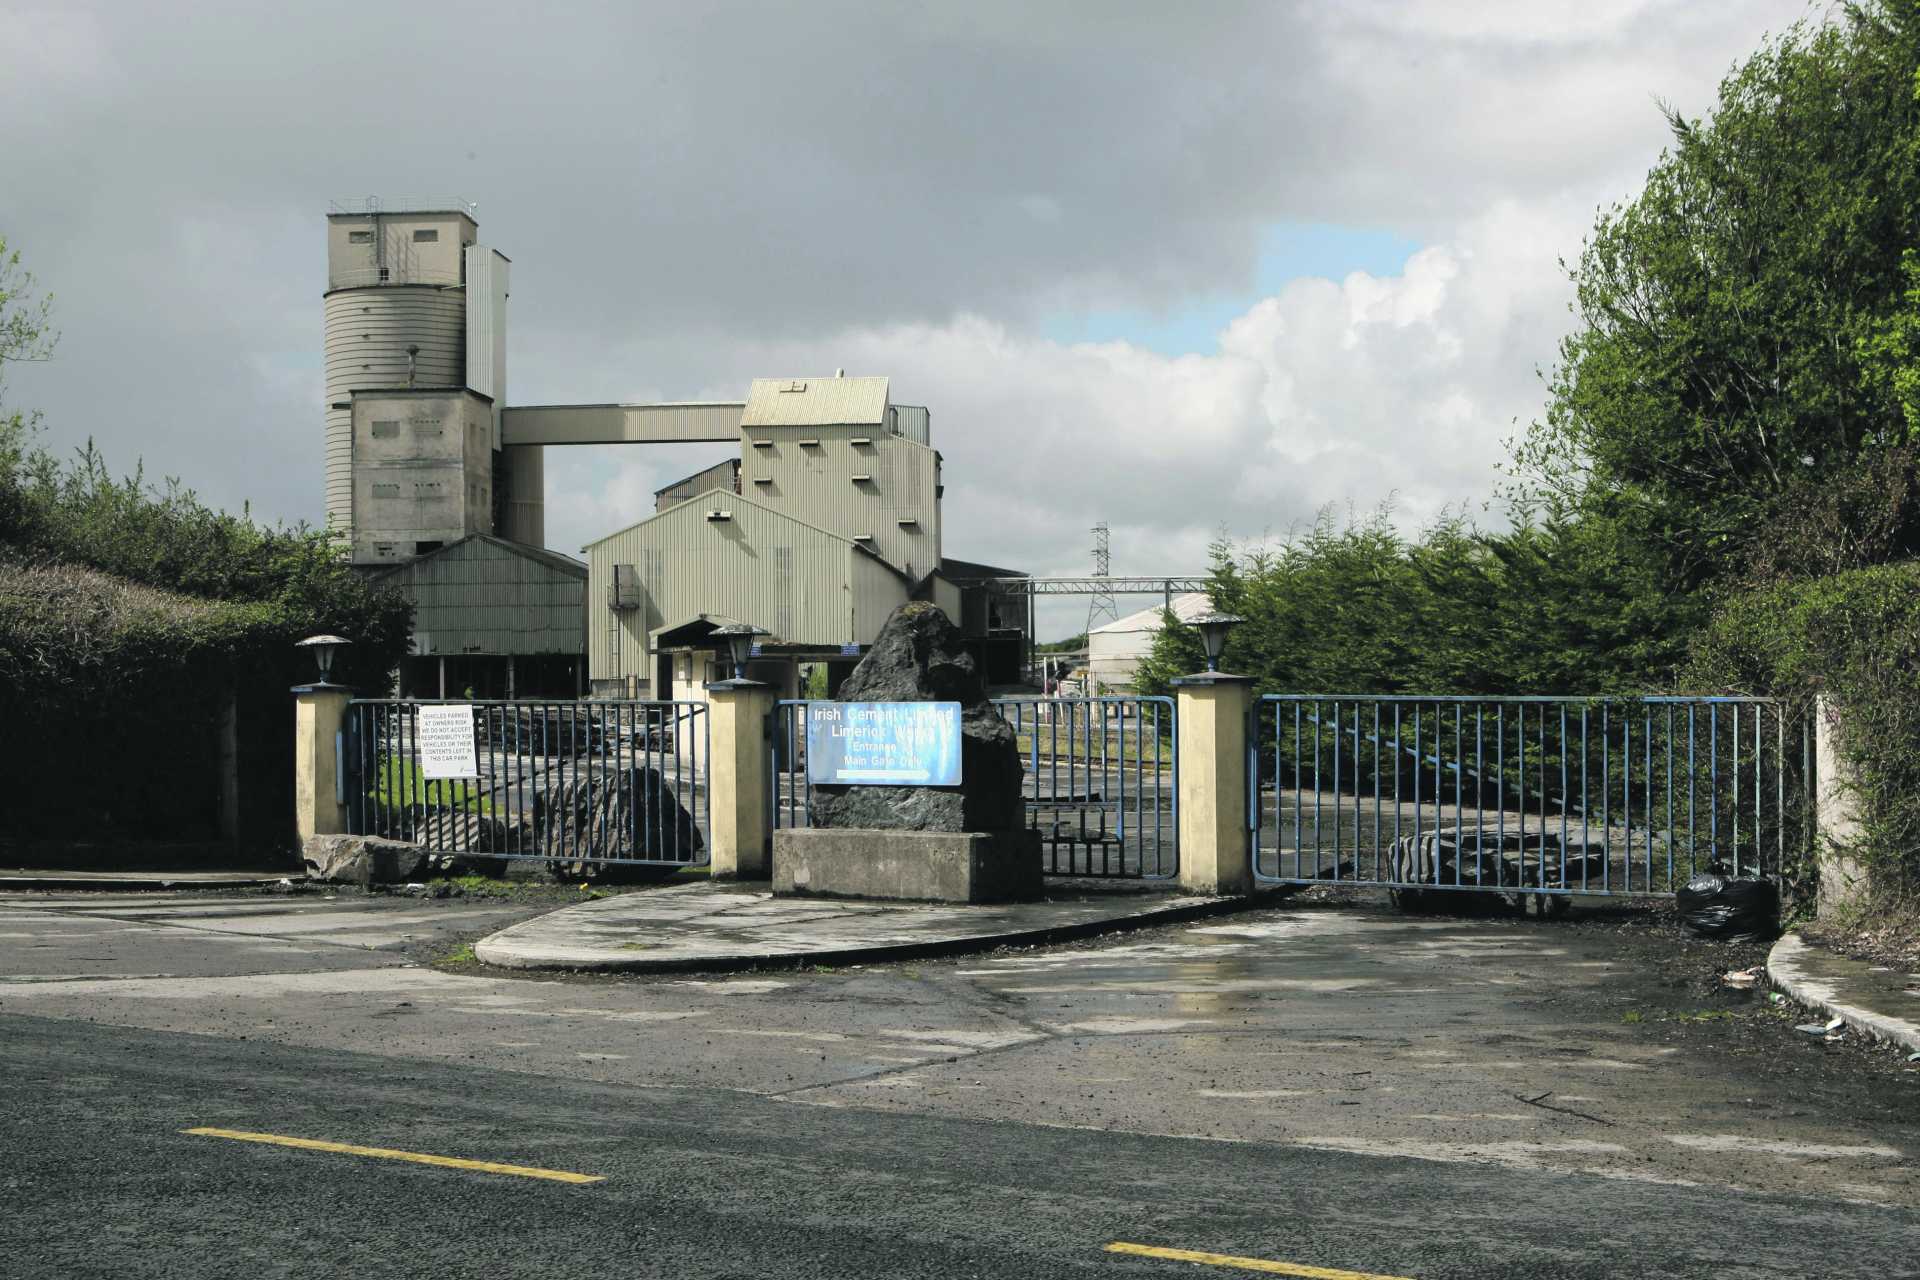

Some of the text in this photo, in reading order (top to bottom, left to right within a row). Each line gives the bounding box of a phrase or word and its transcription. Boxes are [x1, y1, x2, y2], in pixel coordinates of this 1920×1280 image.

[815, 708, 840, 720] Irish
[848, 708, 898, 720] Cement
[844, 756, 866, 765] Main
